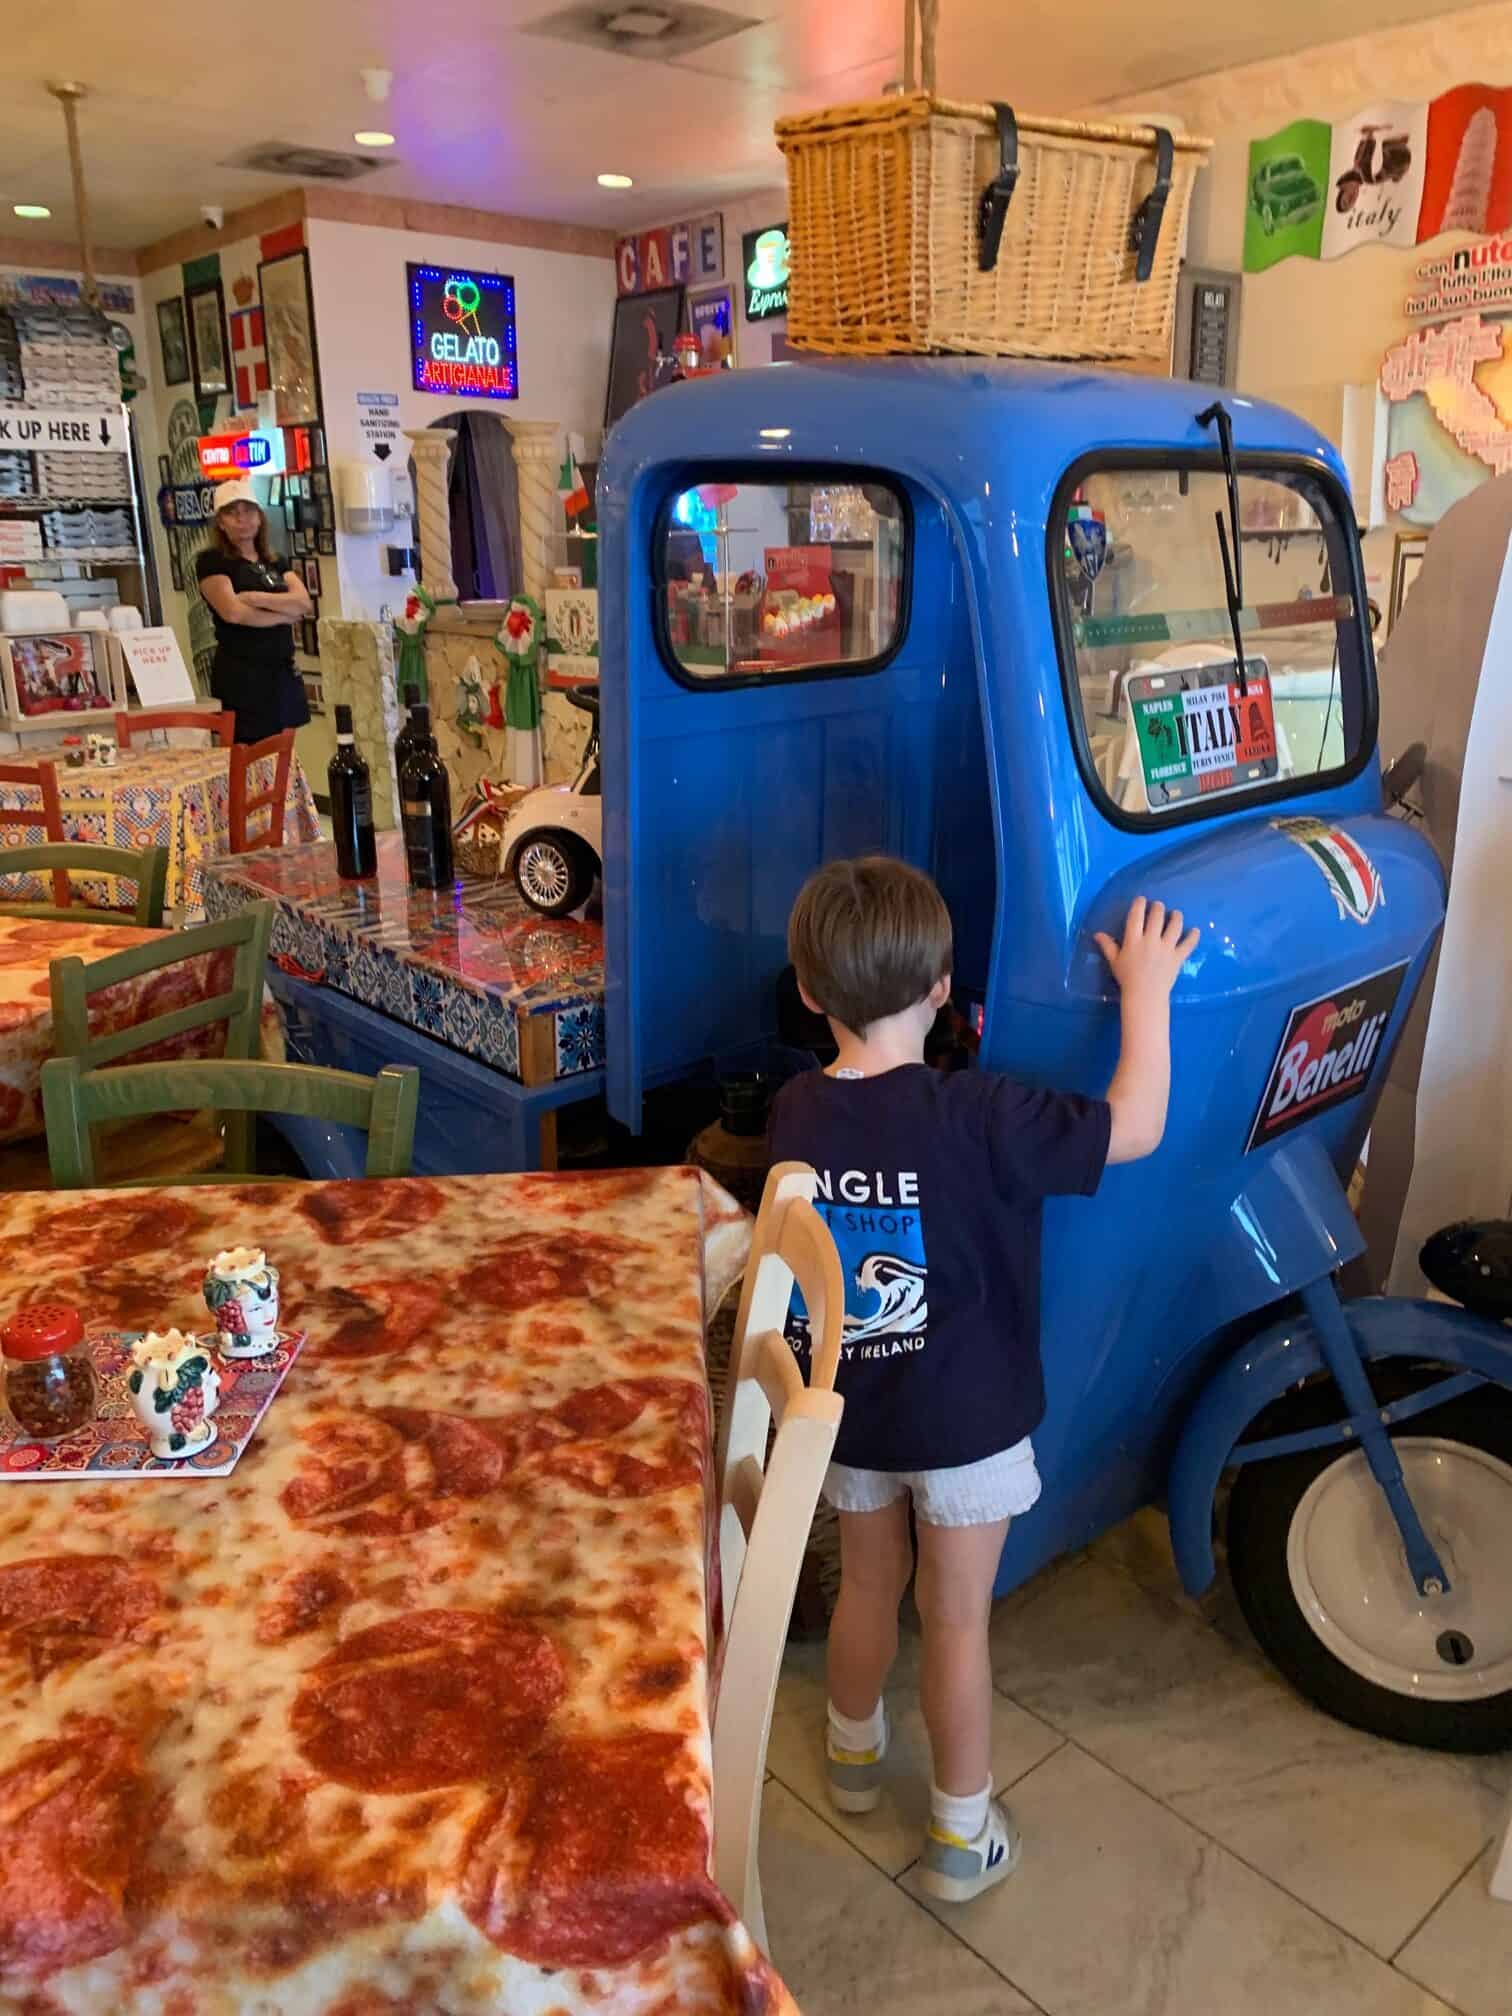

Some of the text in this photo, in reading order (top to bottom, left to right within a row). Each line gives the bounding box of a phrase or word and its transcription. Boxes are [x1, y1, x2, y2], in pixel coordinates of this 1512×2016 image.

[1347, 200, 1402, 237] italy
[620, 226, 716, 291] CAFE
[1442, 274, 1477, 289] tutta
[1443, 295, 1468, 305] suo
[1473, 287, 1512, 301] buon
[431, 332, 500, 366] GELATO
[422, 361, 512, 390] ARTIGIANALE
[368, 408, 389, 417] HAND
[18, 420, 42, 440] UP
[49, 421, 91, 442] HERE
[366, 430, 396, 440] STATION
[1143, 700, 1173, 714] NAPLES
[1186, 694, 1208, 706] MILAN
[1174, 703, 1243, 757] ITALY
[1150, 762, 1187, 780] FLORENCE
[1321, 1000, 1367, 1036] moto
[1268, 1011, 1386, 1117] Benelli
[813, 1169, 920, 1205] NGLE
[847, 1211, 915, 1235] SHOP
[860, 1336, 926, 1361] IRELAND
